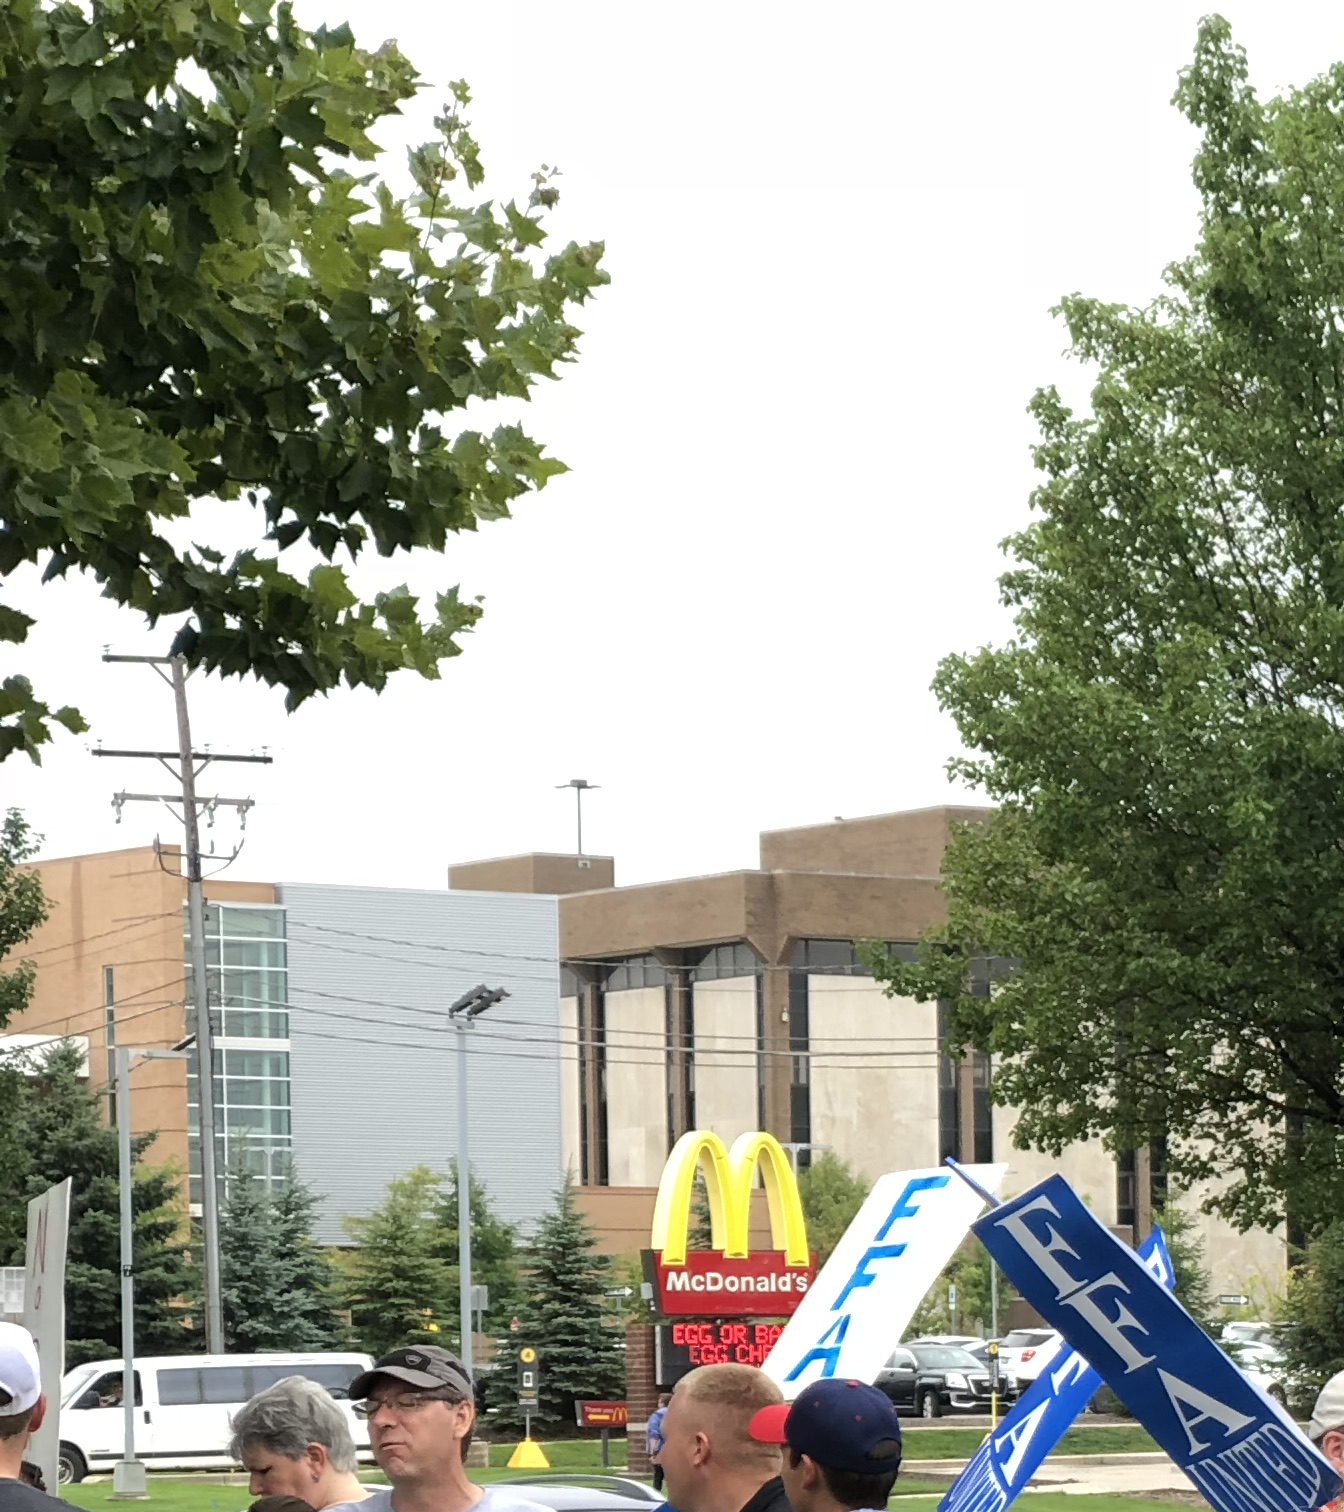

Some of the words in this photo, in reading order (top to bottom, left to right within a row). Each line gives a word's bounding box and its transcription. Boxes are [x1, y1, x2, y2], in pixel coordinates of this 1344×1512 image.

[665, 1271, 808, 1293] McDonald's
[783, 1175, 952, 1383] FFA
[672, 1324, 713, 1345] EGG
[719, 1324, 748, 1345] OR
[993, 1194, 1256, 1456] FFA
[689, 1344, 728, 1364] EGG
